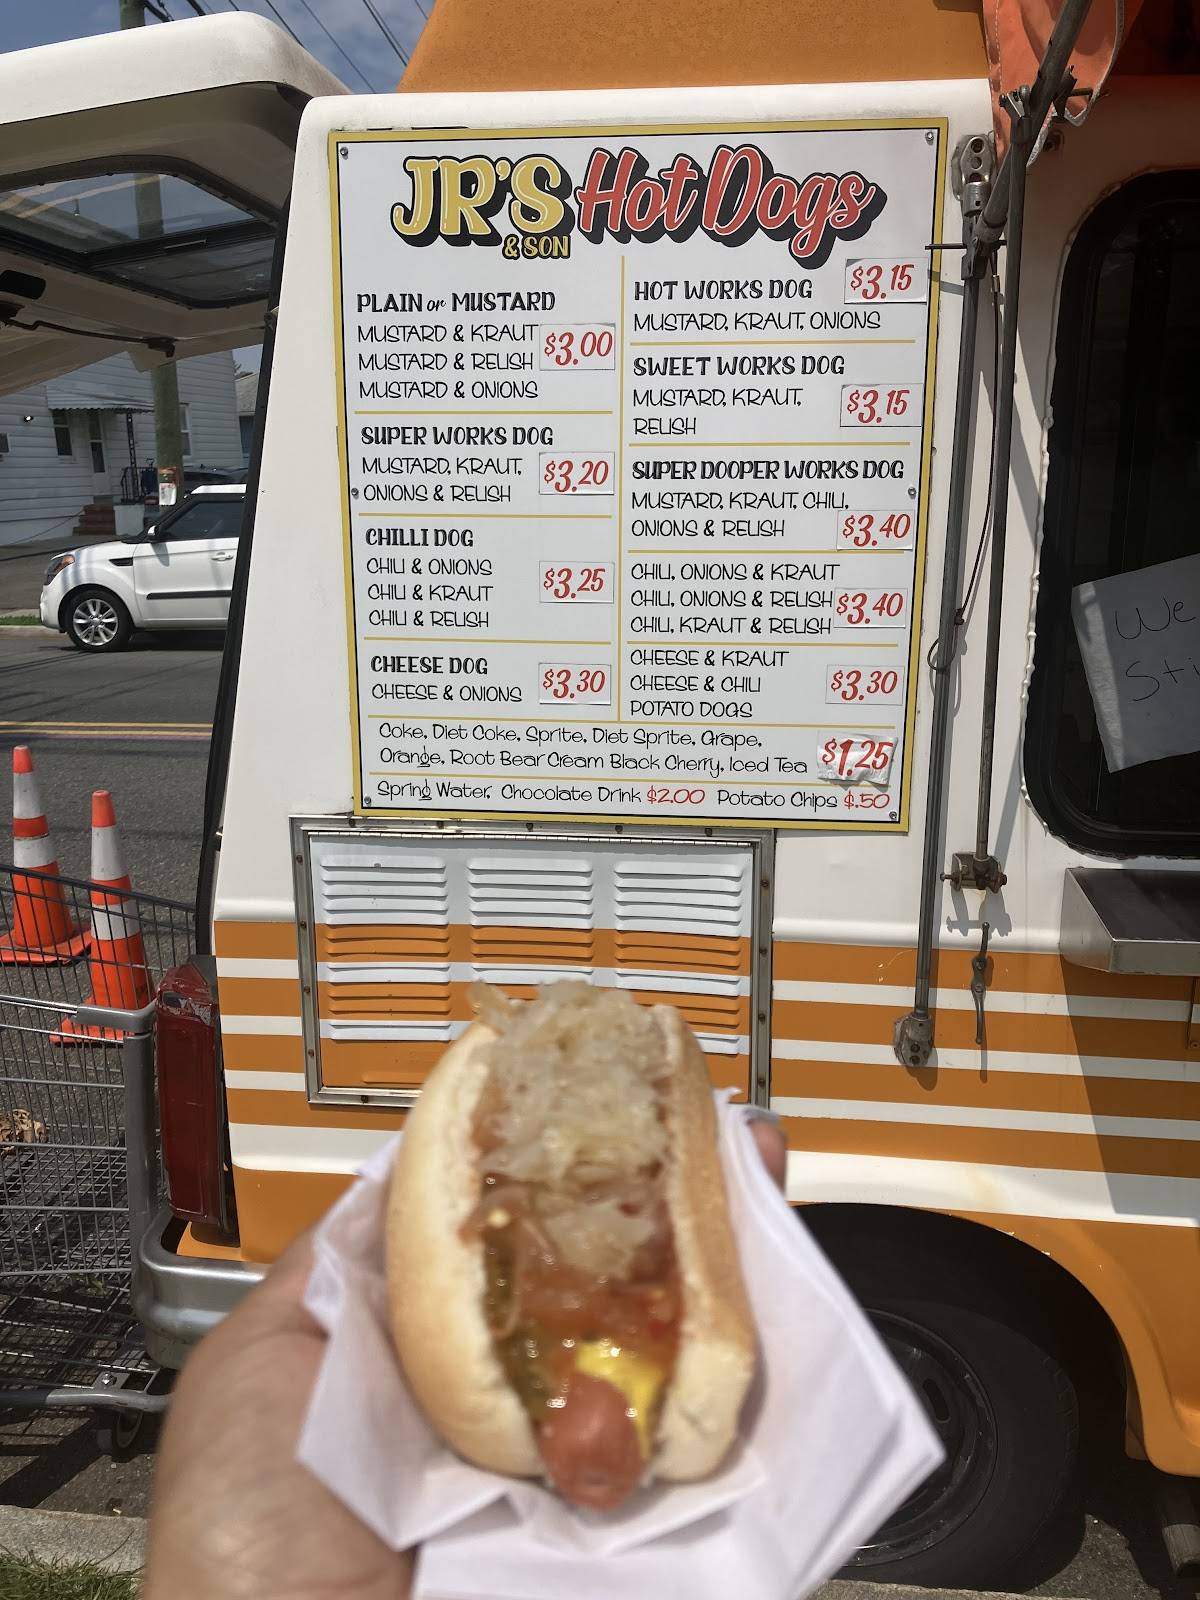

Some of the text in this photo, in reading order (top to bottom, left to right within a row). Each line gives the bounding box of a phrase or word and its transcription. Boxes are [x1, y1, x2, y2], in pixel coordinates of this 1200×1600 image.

[391, 144, 888, 270] JR'S Hot Dogs
[503, 234, 571, 259] & SON
[634, 280, 812, 300] HOT WORKS DOG
[850, 264, 914, 299] $3.15
[356, 292, 555, 312] PLAIN or MUSTARD
[810, 311, 880, 329] ONIONS
[358, 325, 538, 342] MUSTARD & KRAUT
[544, 332, 613, 365] $3.00
[359, 353, 533, 370] MUSTARD & RELISH
[634, 356, 844, 376] SWEET WORKS DOG
[359, 381, 538, 398] MUSTARD & ONIONS
[847, 389, 910, 424] $3.15
[361, 427, 553, 445] SUPER WORKS DOG
[633, 418, 696, 435] RELISH
[544, 460, 608, 492] $3.20
[632, 460, 904, 480] SUPER DOOPER WORKS DOG
[364, 485, 510, 501] ONIONS & RELISH
[365, 528, 474, 546] CHILLI DOG
[632, 520, 784, 536] ONIONS & RELISH
[842, 514, 911, 546] $3.40
[366, 558, 492, 575] CHILI & ONIONS
[680, 564, 747, 580] ONIONS
[752, 564, 764, 580] &
[770, 564, 840, 581] KRAUT
[368, 584, 493, 601] CHILI & KRAUT
[543, 568, 605, 599] $3.25
[680, 590, 746, 607] ONIONS
[752, 590, 762, 608] &
[770, 591, 832, 608] RELISH
[836, 592, 904, 624] $3.40
[369, 610, 489, 627] CHILI & RELISH
[680, 617, 746, 633] KRAUT
[750, 617, 762, 634] &
[769, 617, 830, 634] RELISH
[1115, 596, 1196, 640] We
[371, 656, 488, 674] CHEESE DOG
[630, 650, 789, 667] CHEESE & KRAUT
[372, 684, 522, 702] CHEESE & ONIONS
[543, 669, 605, 698] $3.30
[630, 675, 760, 692] CHEESE & CHILI
[830, 670, 898, 700] $3.30
[630, 700, 752, 718] POTATO DOGS
[433, 724, 467, 739] Diet
[592, 728, 628, 744] Diet
[450, 750, 495, 765] Root
[500, 751, 545, 767] Bear
[548, 752, 603, 768] Cream
[610, 753, 660, 770] Black
[729, 757, 769, 772] Iced
[774, 757, 808, 773] Tea
[822, 739, 894, 776] $1.25
[377, 778, 431, 800] Spring
[501, 784, 592, 801] Chocolate
[598, 786, 642, 803] Drink
[647, 786, 705, 804] $2.00
[717, 789, 785, 807] Potato
[791, 791, 837, 811] Chips
[843, 791, 890, 810] $.50
